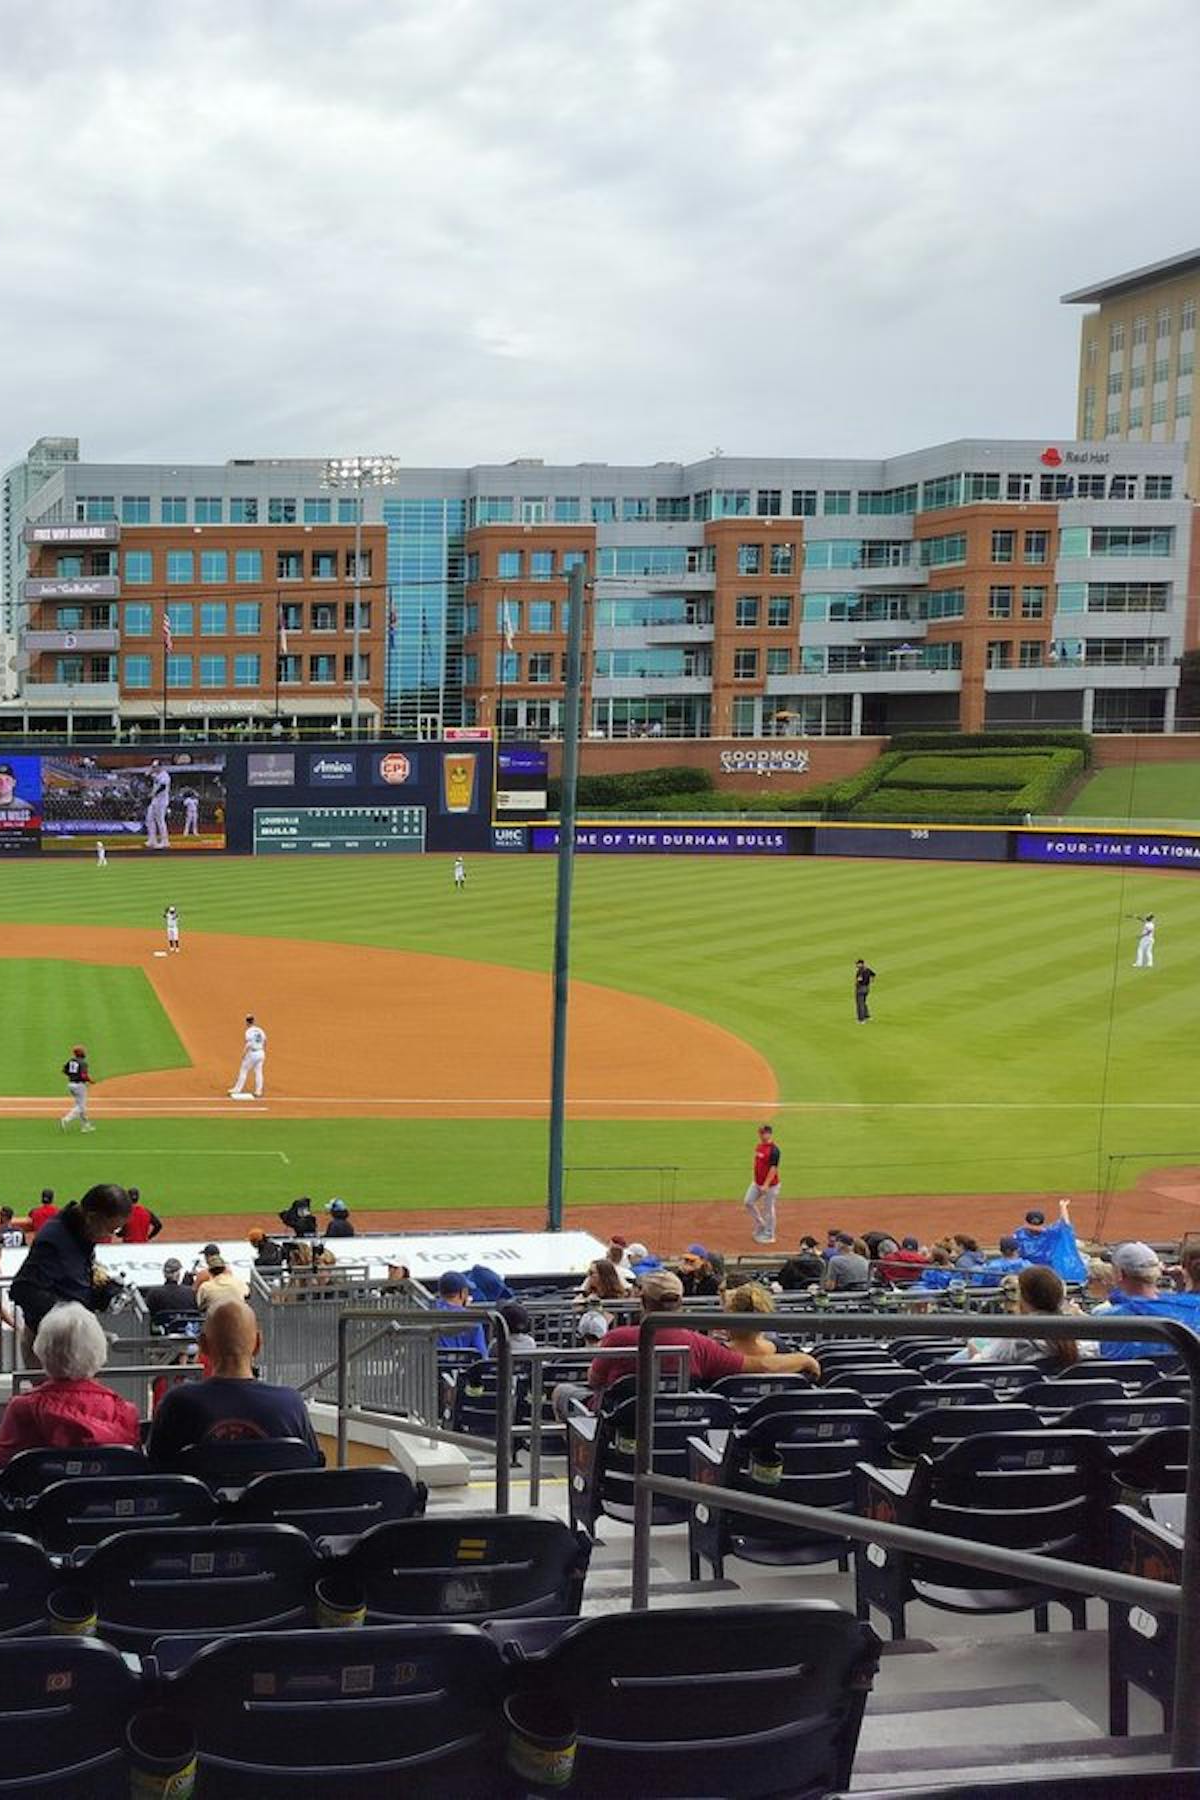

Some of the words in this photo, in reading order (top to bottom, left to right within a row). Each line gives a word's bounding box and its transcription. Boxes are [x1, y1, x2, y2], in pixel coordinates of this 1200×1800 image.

[1066, 452, 1087, 464] Red
[1089, 453, 1110, 464] Hat
[720, 750, 809, 761] GOODMON
[313, 759, 353, 773] Amica
[261, 827, 298, 836] BULLS
[603, 835, 623, 845] OF
[628, 835, 656, 845] THE
[663, 835, 729, 845] DURHAM
[737, 835, 784, 846] BULLS
[1046, 842, 1132, 855] FOUR-TIME
[416, 1251, 468, 1263] for
[480, 1248, 522, 1261] all
